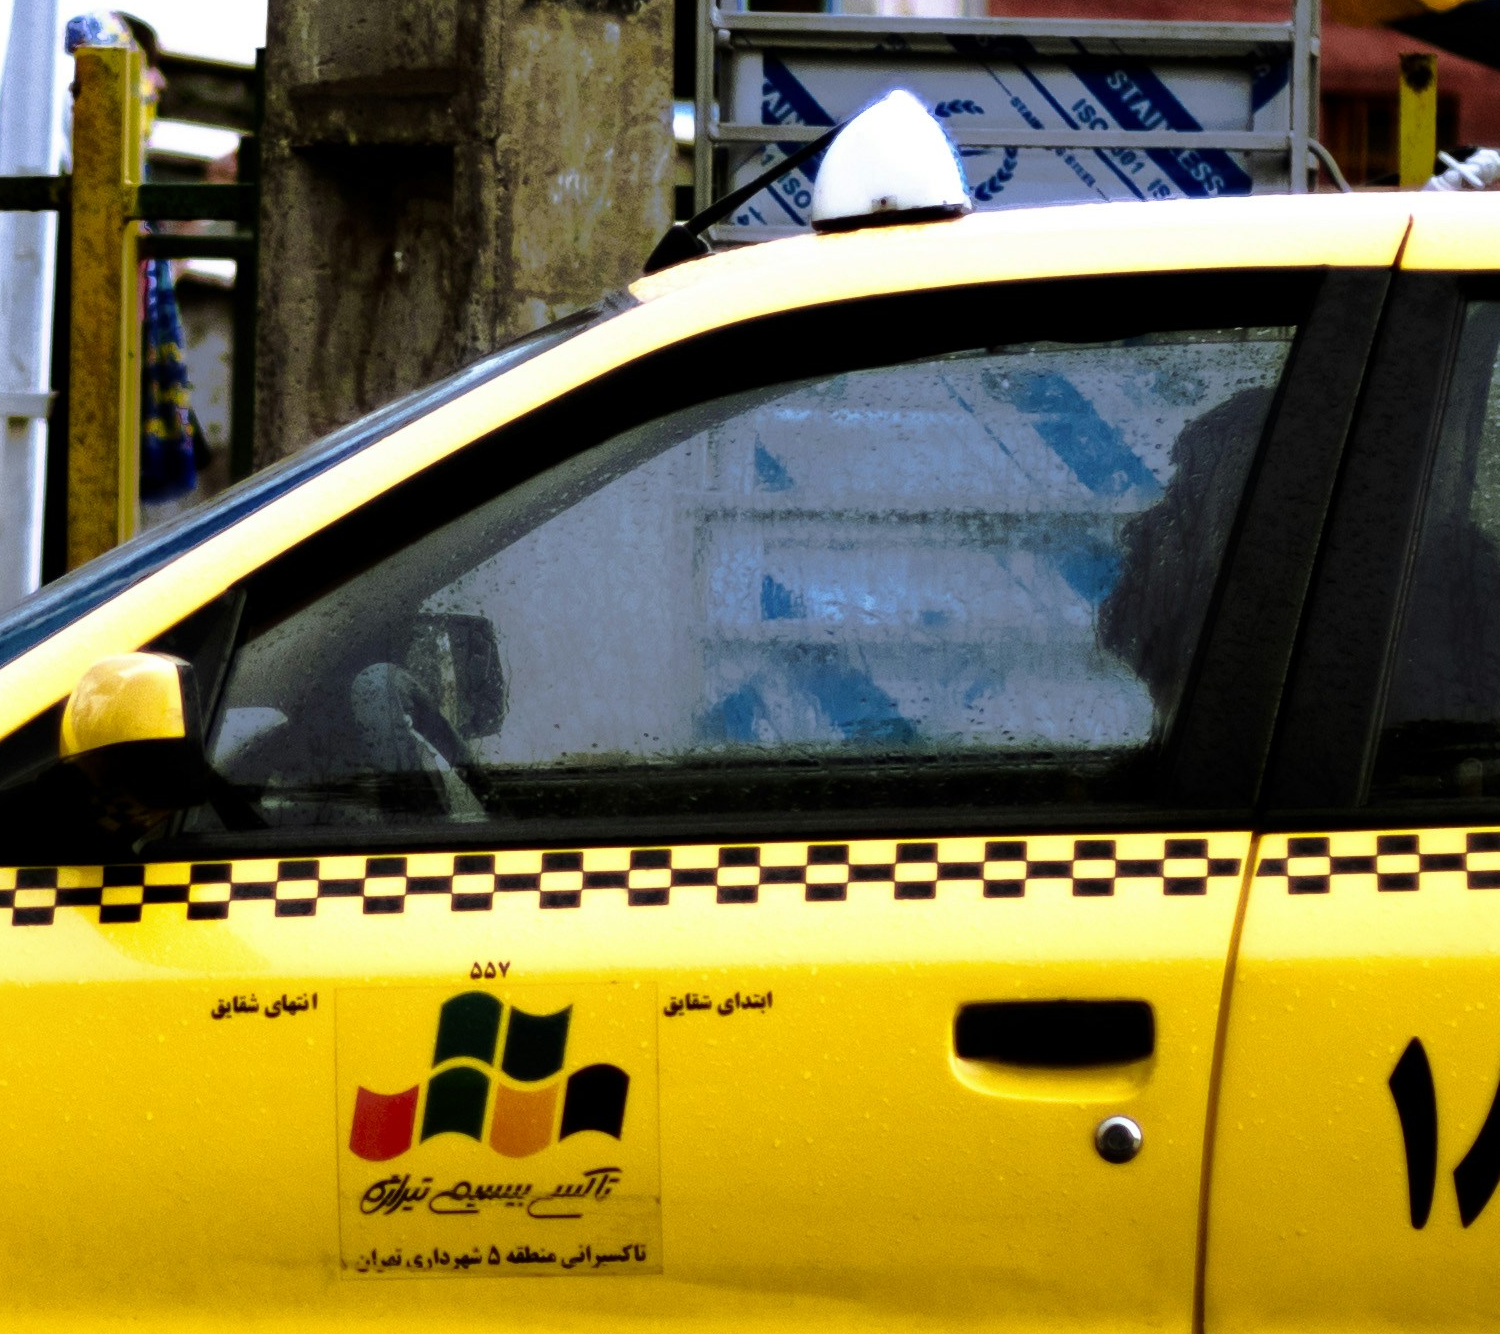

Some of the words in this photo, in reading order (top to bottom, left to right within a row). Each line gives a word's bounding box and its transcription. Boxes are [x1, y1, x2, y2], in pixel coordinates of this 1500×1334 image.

[1106, 69, 1225, 196] STAIESS
[486, 1245, 501, 1266] ۵
[505, 1245, 557, 1265] منطقه
